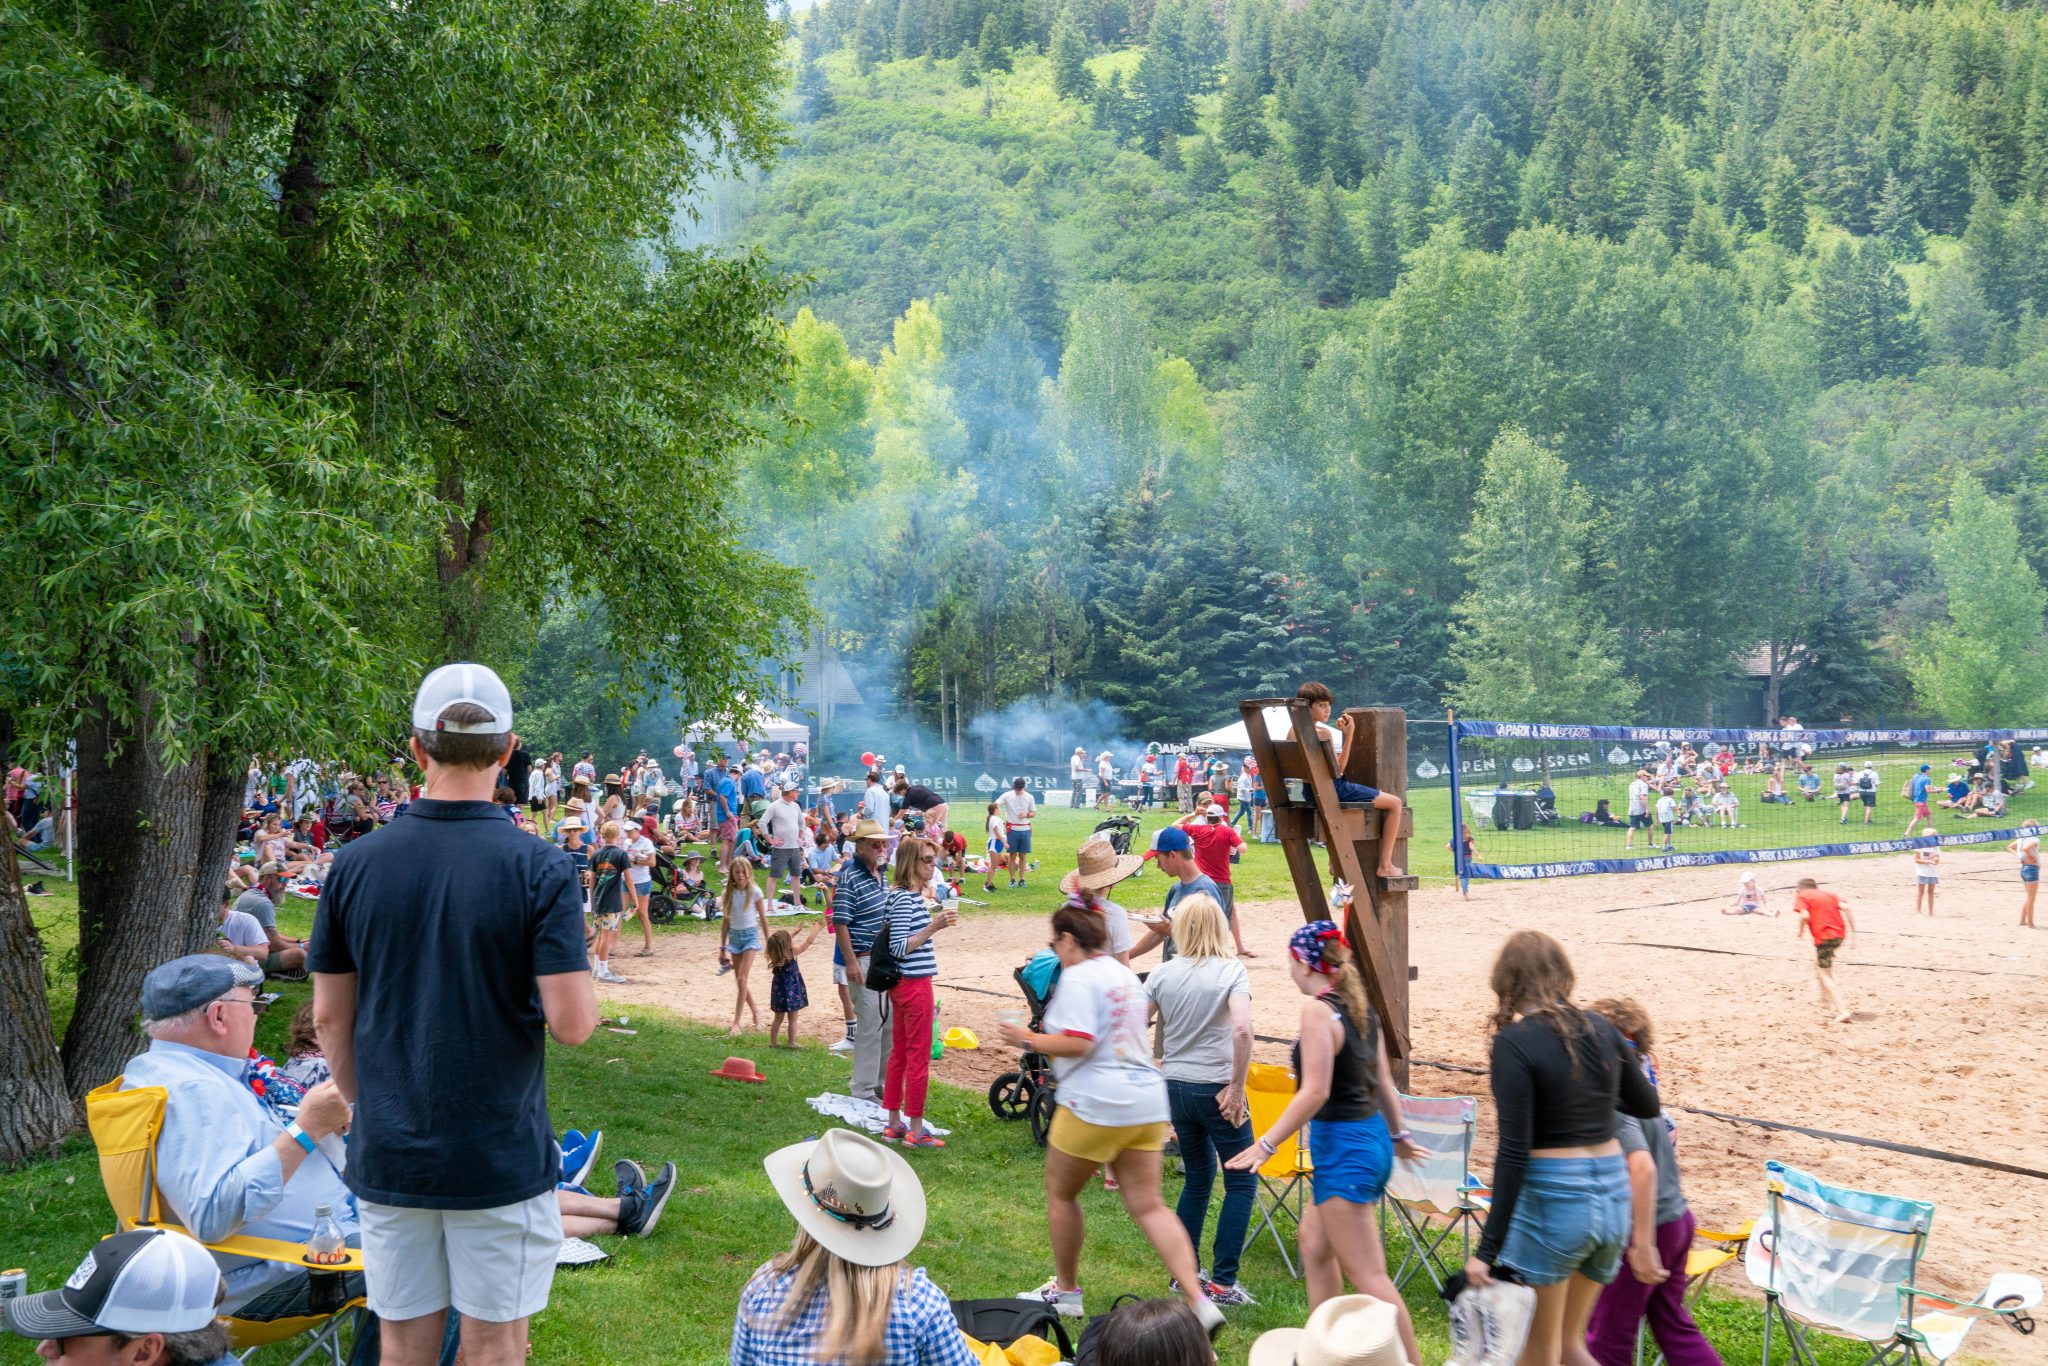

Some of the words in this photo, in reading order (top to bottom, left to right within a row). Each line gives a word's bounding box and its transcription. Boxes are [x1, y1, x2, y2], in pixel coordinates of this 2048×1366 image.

[1506, 724, 1530, 737] PARK
[1531, 724, 1539, 737] &
[1639, 728, 1661, 740] PARK
[1661, 728, 1668, 740] &
[1440, 758, 1496, 775] APEN
[1001, 776, 1057, 789] APEN
[1758, 850, 1777, 862] PARK
[1777, 850, 1783, 861] &
[1645, 857, 1665, 870] PARK
[1666, 856, 1673, 868] &
[1512, 866, 1536, 879] PARK
[1537, 865, 1545, 878] &
